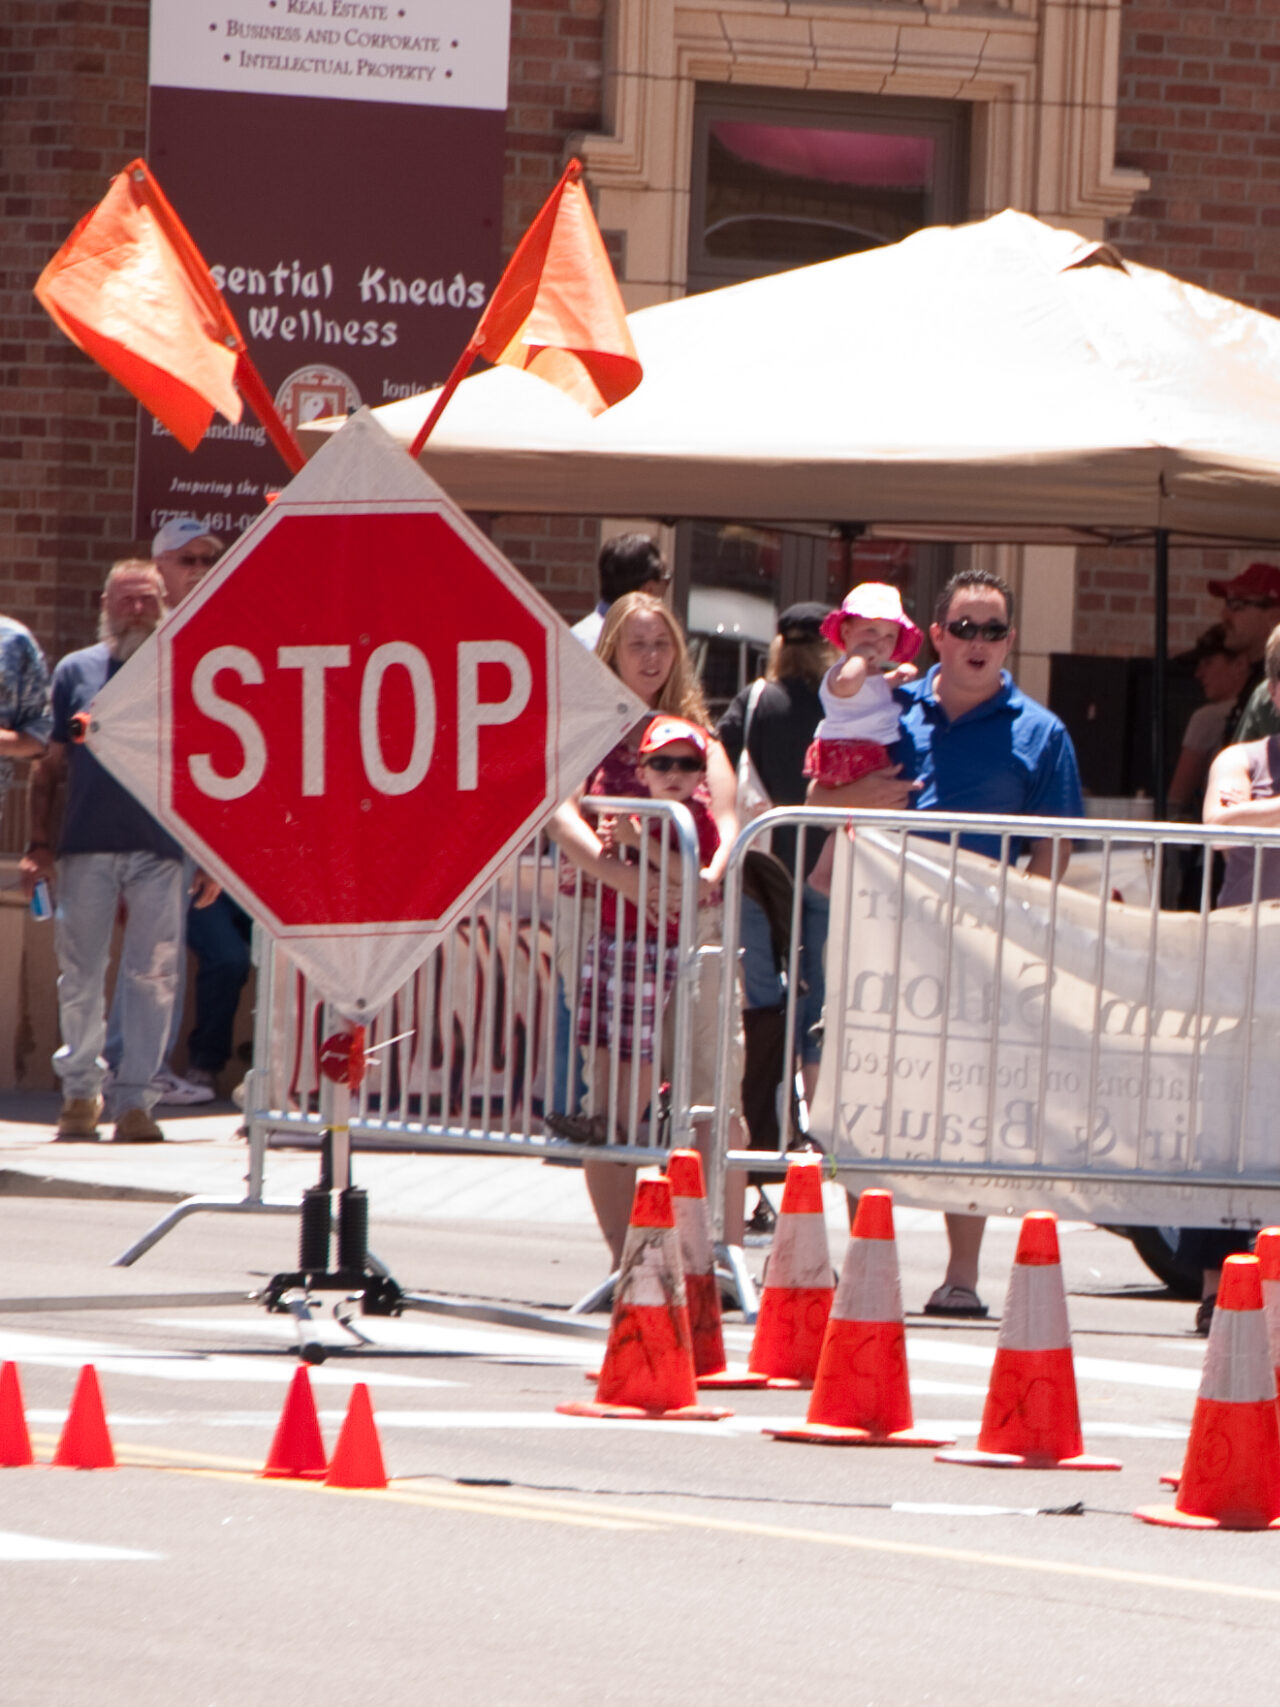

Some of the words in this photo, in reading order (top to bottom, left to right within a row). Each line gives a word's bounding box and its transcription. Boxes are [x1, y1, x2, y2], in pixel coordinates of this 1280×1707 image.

[358, 265, 486, 308] Kneads
[249, 306, 398, 347] Wellness
[187, 640, 533, 801] STOP
